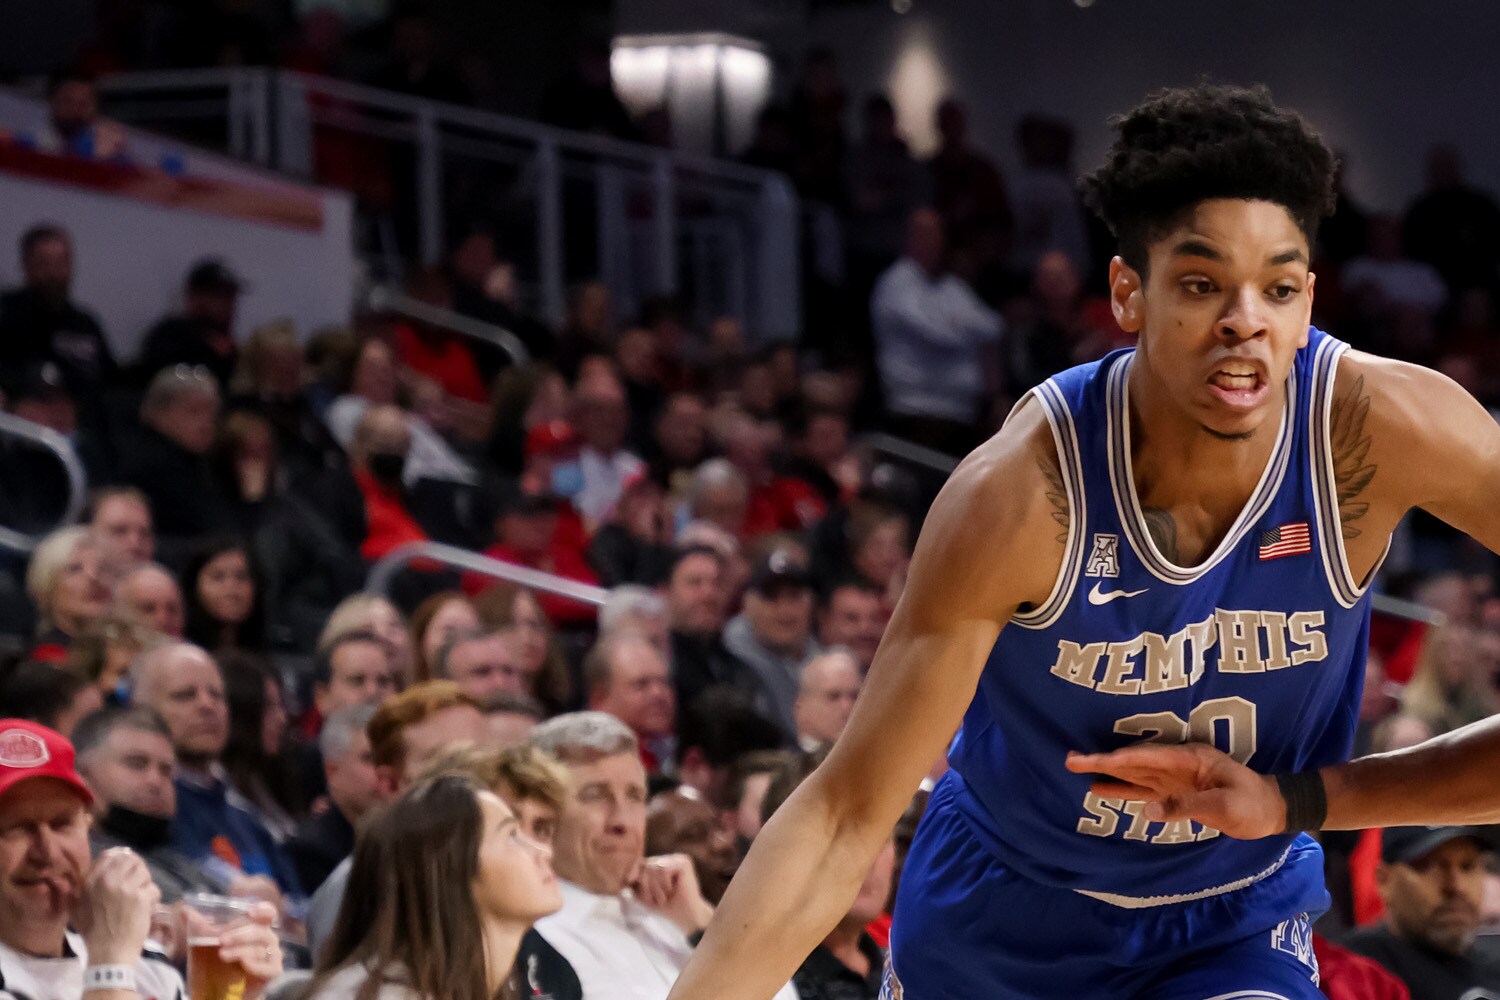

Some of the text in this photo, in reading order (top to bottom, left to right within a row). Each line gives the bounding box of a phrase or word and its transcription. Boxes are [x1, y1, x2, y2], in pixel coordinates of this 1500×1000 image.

[1085, 533, 1120, 577] A
[1050, 607, 1329, 695] MEMPHIS
[1076, 791, 1221, 844] STA
